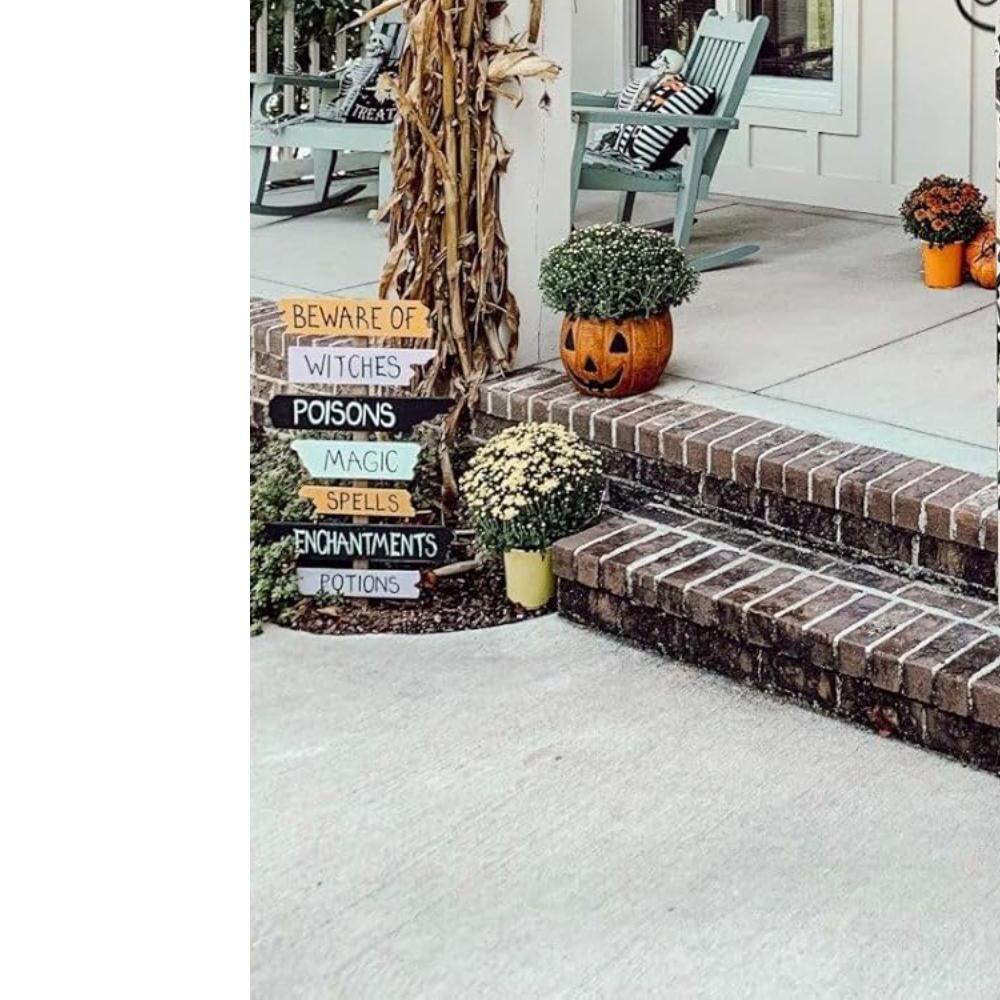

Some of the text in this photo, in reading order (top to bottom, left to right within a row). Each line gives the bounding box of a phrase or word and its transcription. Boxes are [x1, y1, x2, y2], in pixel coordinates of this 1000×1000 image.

[352, 103, 398, 121] TREAT
[292, 304, 419, 330] BEWARE OF
[304, 353, 402, 379] WITCHES
[293, 399, 397, 428] POISONS
[323, 450, 399, 473] MAGIC
[327, 491, 399, 513] SPELLS
[293, 528, 438, 558] ENCHANTMENTS
[320, 573, 400, 594] POTIONS
